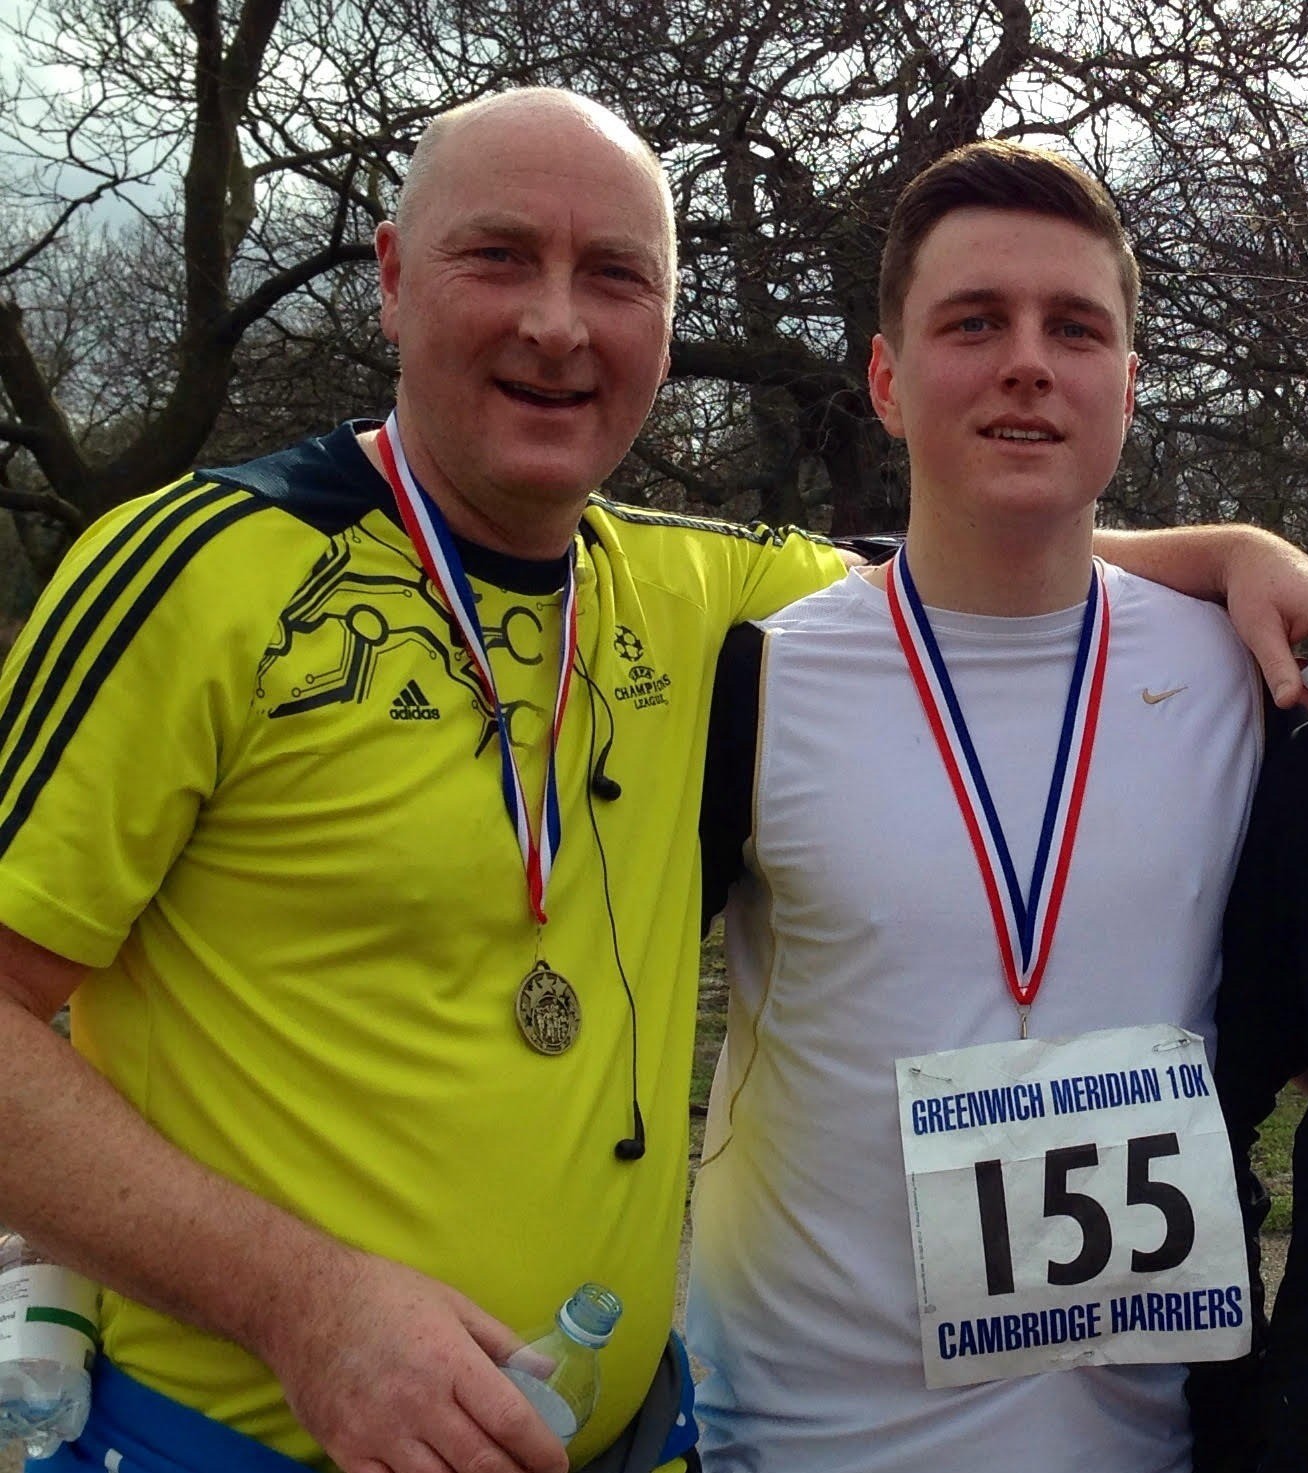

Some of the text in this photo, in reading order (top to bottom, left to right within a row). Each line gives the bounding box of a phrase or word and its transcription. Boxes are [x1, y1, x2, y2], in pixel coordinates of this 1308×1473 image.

[389, 705, 441, 720] adidas
[911, 1063, 1210, 1136] GREENWICH MERIDIAN 10K
[975, 1132, 1195, 1296] 155
[938, 1285, 1243, 1360] CAMBRIDGE HARRIERS
